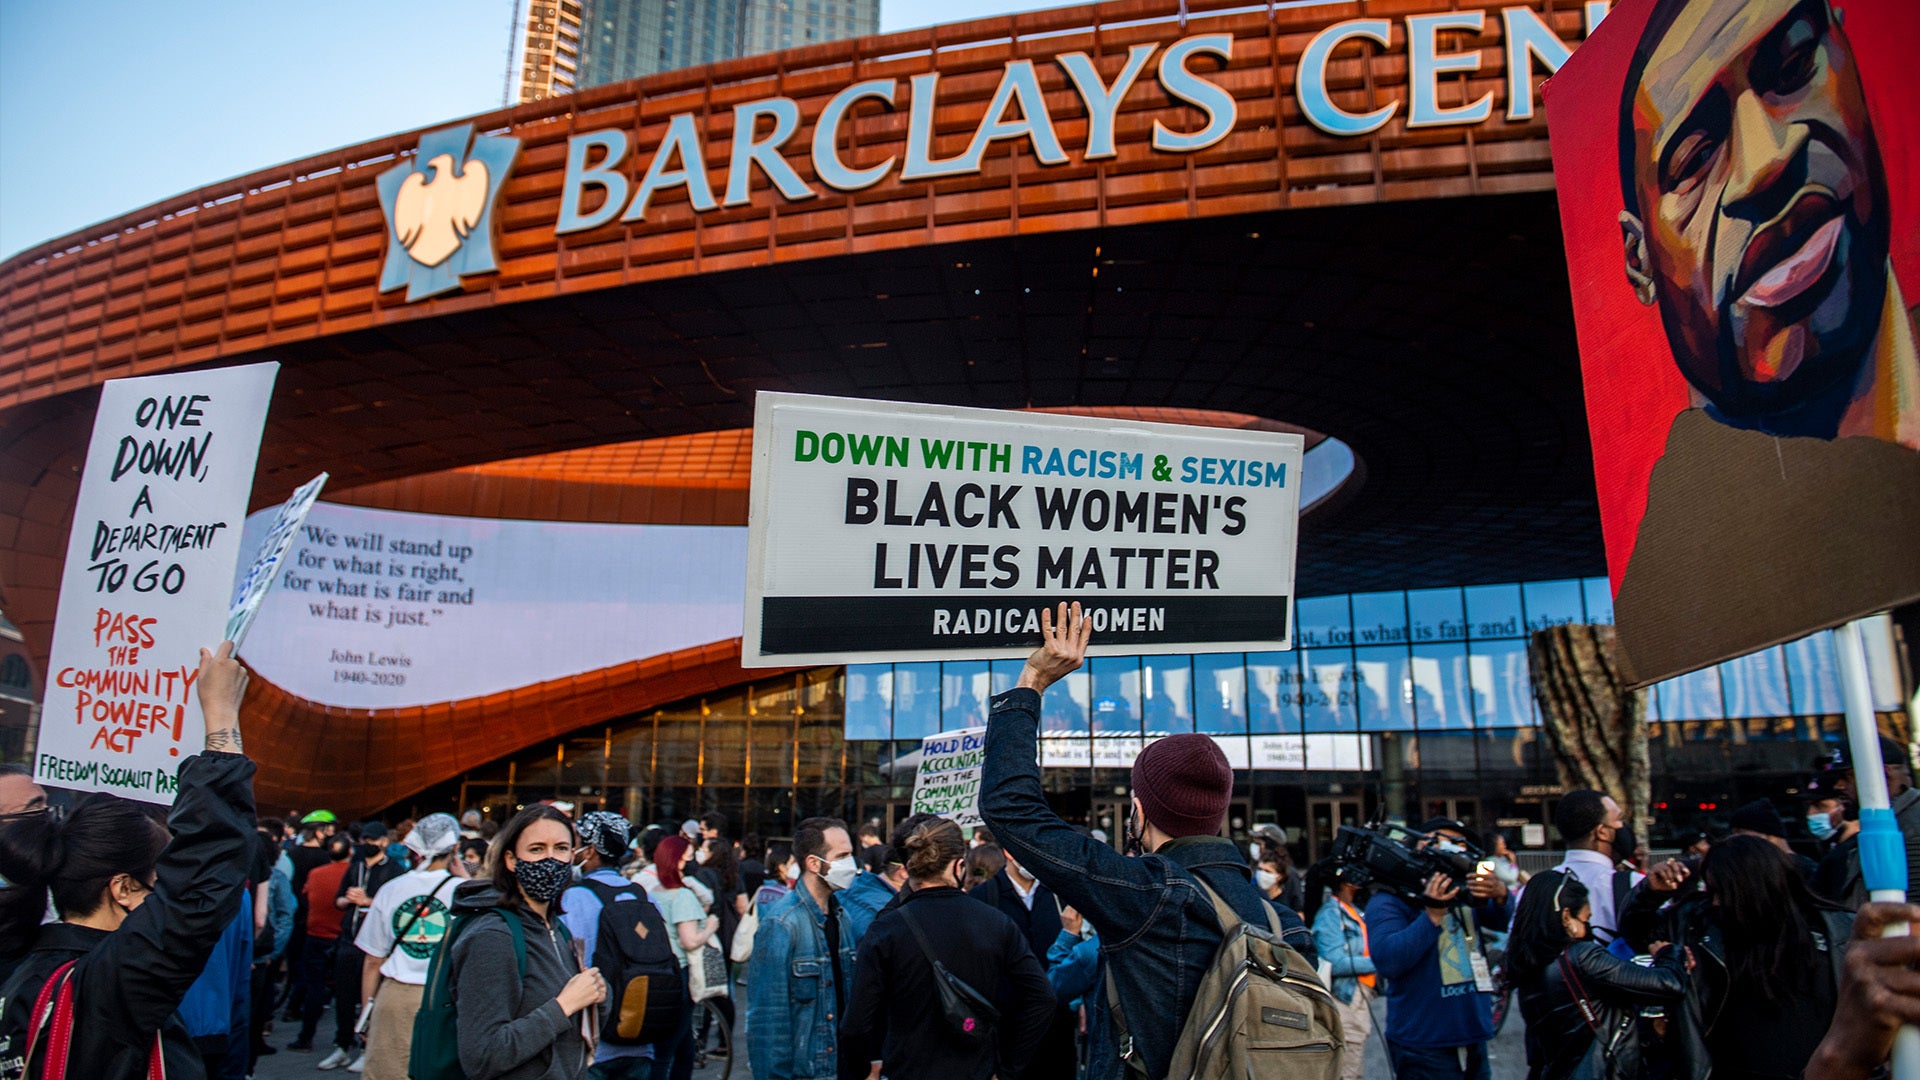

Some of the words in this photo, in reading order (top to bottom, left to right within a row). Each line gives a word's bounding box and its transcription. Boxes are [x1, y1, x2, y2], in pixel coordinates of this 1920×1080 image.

[555, 33, 1238, 235] BARCLAYS
[136, 395, 211, 430] ONE
[111, 432, 212, 482] DOWN,
[794, 430, 909, 468] DOWN
[920, 438, 1011, 473] WITH
[1021, 446, 1143, 481] RACISM
[1151, 454, 1173, 482] &
[1180, 456, 1286, 489] SEXISM
[129, 485, 153, 518] A
[844, 477, 1022, 530] BLACK
[1034, 486, 1248, 536] WOMEN'S
[91, 520, 227, 561] DEPARTMENT
[344, 533, 383, 552] will
[389, 536, 442, 557] stand
[448, 545, 473, 564] up
[87, 558, 128, 593] TO
[133, 560, 185, 594] GO
[297, 549, 327, 570] for
[333, 553, 382, 576] what
[388, 558, 404, 578] is
[411, 560, 464, 585] right,
[873, 542, 1021, 590] LIVES
[1036, 545, 1220, 590] MATTER
[283, 571, 312, 592] for
[318, 575, 367, 598] what
[373, 580, 390, 600] is
[397, 582, 432, 603] fair
[437, 586, 474, 606] and
[93, 607, 157, 649] PASS
[308, 601, 358, 622] what
[365, 604, 382, 623] is
[933, 608, 1056, 636] RADICA
[1328, 625, 1354, 645] for
[1362, 623, 1410, 642] what
[1415, 620, 1433, 640] is
[1439, 619, 1474, 639] fair
[1480, 615, 1517, 635] and
[108, 646, 138, 665] THE
[328, 649, 363, 666] John
[368, 651, 412, 668] Lewis
[56, 665, 199, 703] COMMUNITY
[333, 669, 406, 687] 1940-2020
[91, 727, 142, 754] ACT
[923, 739, 959, 756] HOLD
[40, 754, 98, 786] FREEDOM
[100, 763, 152, 790] SOCIALIST
[923, 774, 949, 785] WITH
[954, 770, 974, 781] THE
[951, 793, 976, 812] ACT
